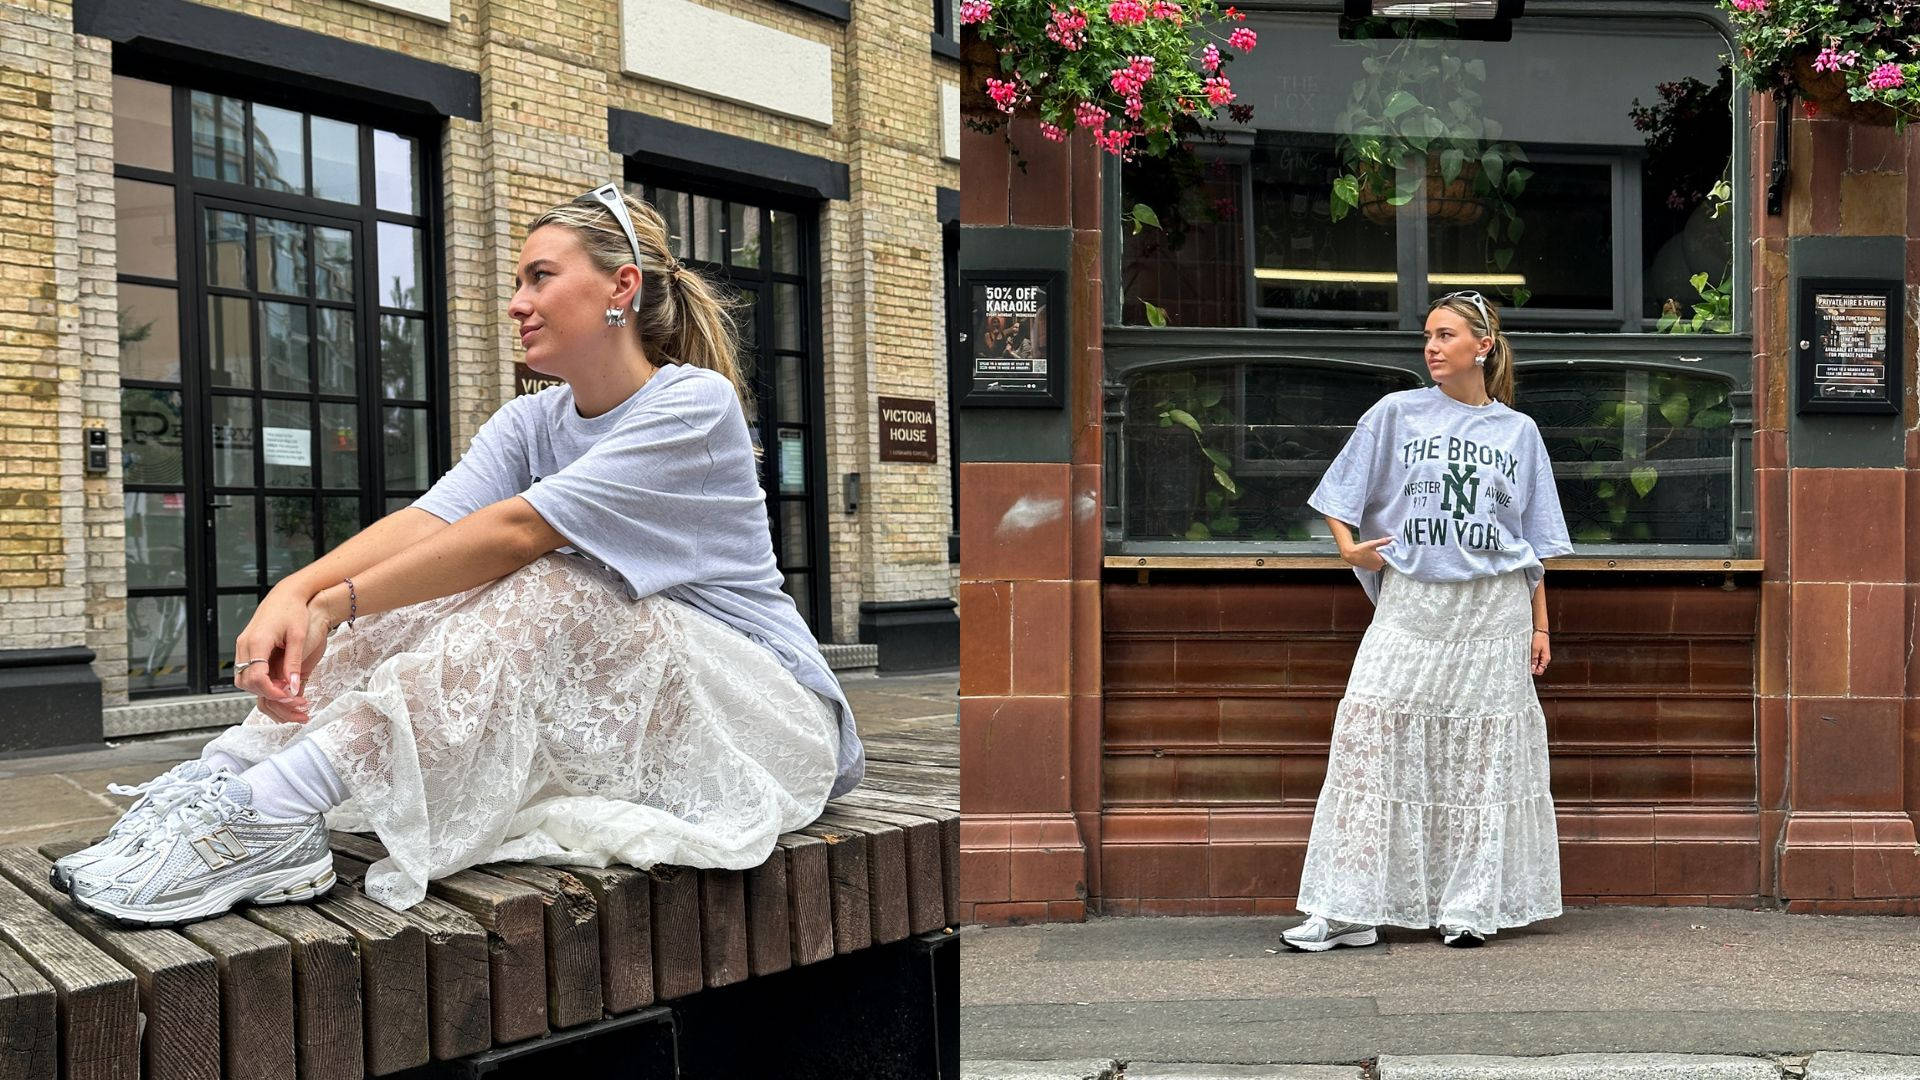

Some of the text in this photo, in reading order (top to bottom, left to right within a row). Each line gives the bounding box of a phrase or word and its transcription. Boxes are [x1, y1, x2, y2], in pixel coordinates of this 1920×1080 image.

[986, 287, 1038, 300] 50% OFF
[986, 300, 1037, 312] KARAOKE
[1818, 298, 1843, 307] PRIVATE
[1843, 299, 1857, 307] HIRE
[1863, 299, 1886, 307] EVENTS
[882, 408, 933, 425] VICTORIA
[890, 427, 927, 443] HOUSE
[1403, 435, 1518, 485] THE BRONX
[1403, 517, 1448, 547] NEW
